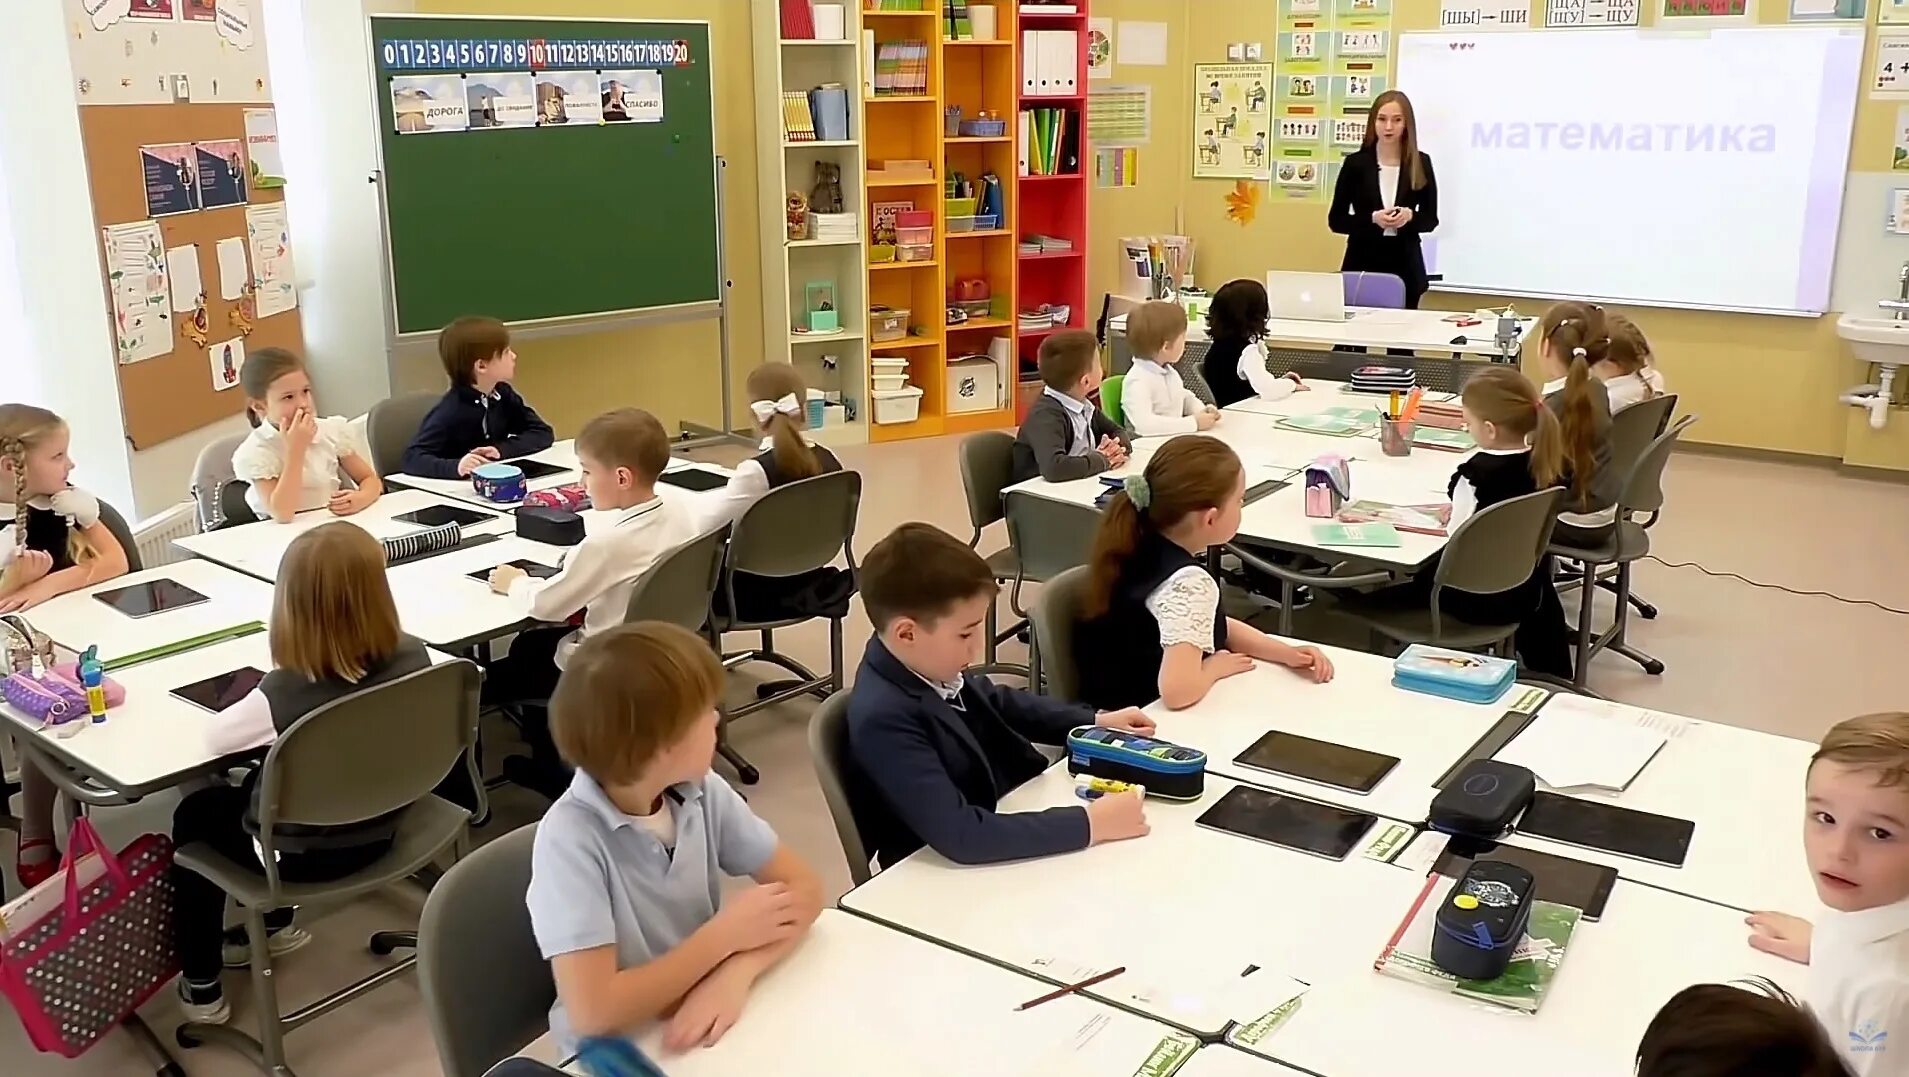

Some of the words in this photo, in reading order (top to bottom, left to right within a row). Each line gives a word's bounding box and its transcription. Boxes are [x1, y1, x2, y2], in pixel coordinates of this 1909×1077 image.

[1442, 10, 1480, 25] [ШЫ]
[1500, 10, 1527, 24] ШИ
[1549, 10, 1585, 24] [ЩУ]
[1607, 10, 1633, 23] ЩУ
[385, 45, 394, 63] 0
[401, 45, 409, 63] 1
[415, 45, 425, 63] 2
[431, 45, 440, 63] 3
[446, 45, 455, 63] 4
[461, 45, 469, 63] 5
[475, 45, 484, 63] 6
[489, 45, 498, 63] 7
[504, 45, 513, 63] 8
[517, 45, 526, 63] 9
[530, 44, 543, 62] 10
[547, 44, 558, 62] 11
[561, 44, 574, 62] 12
[576, 44, 588, 62] 13
[591, 44, 604, 62] 14
[607, 44, 618, 62] 15
[620, 44, 633, 62] 16
[634, 44, 646, 62] 17
[650, 44, 661, 62] 18
[662, 44, 673, 62] 19
[675, 44, 687, 62] 20
[1884, 62, 1893, 73] 4
[625, 101, 658, 109] СПАСИБО
[427, 107, 463, 118] ДОРОГА
[1470, 121, 1776, 153] математика
